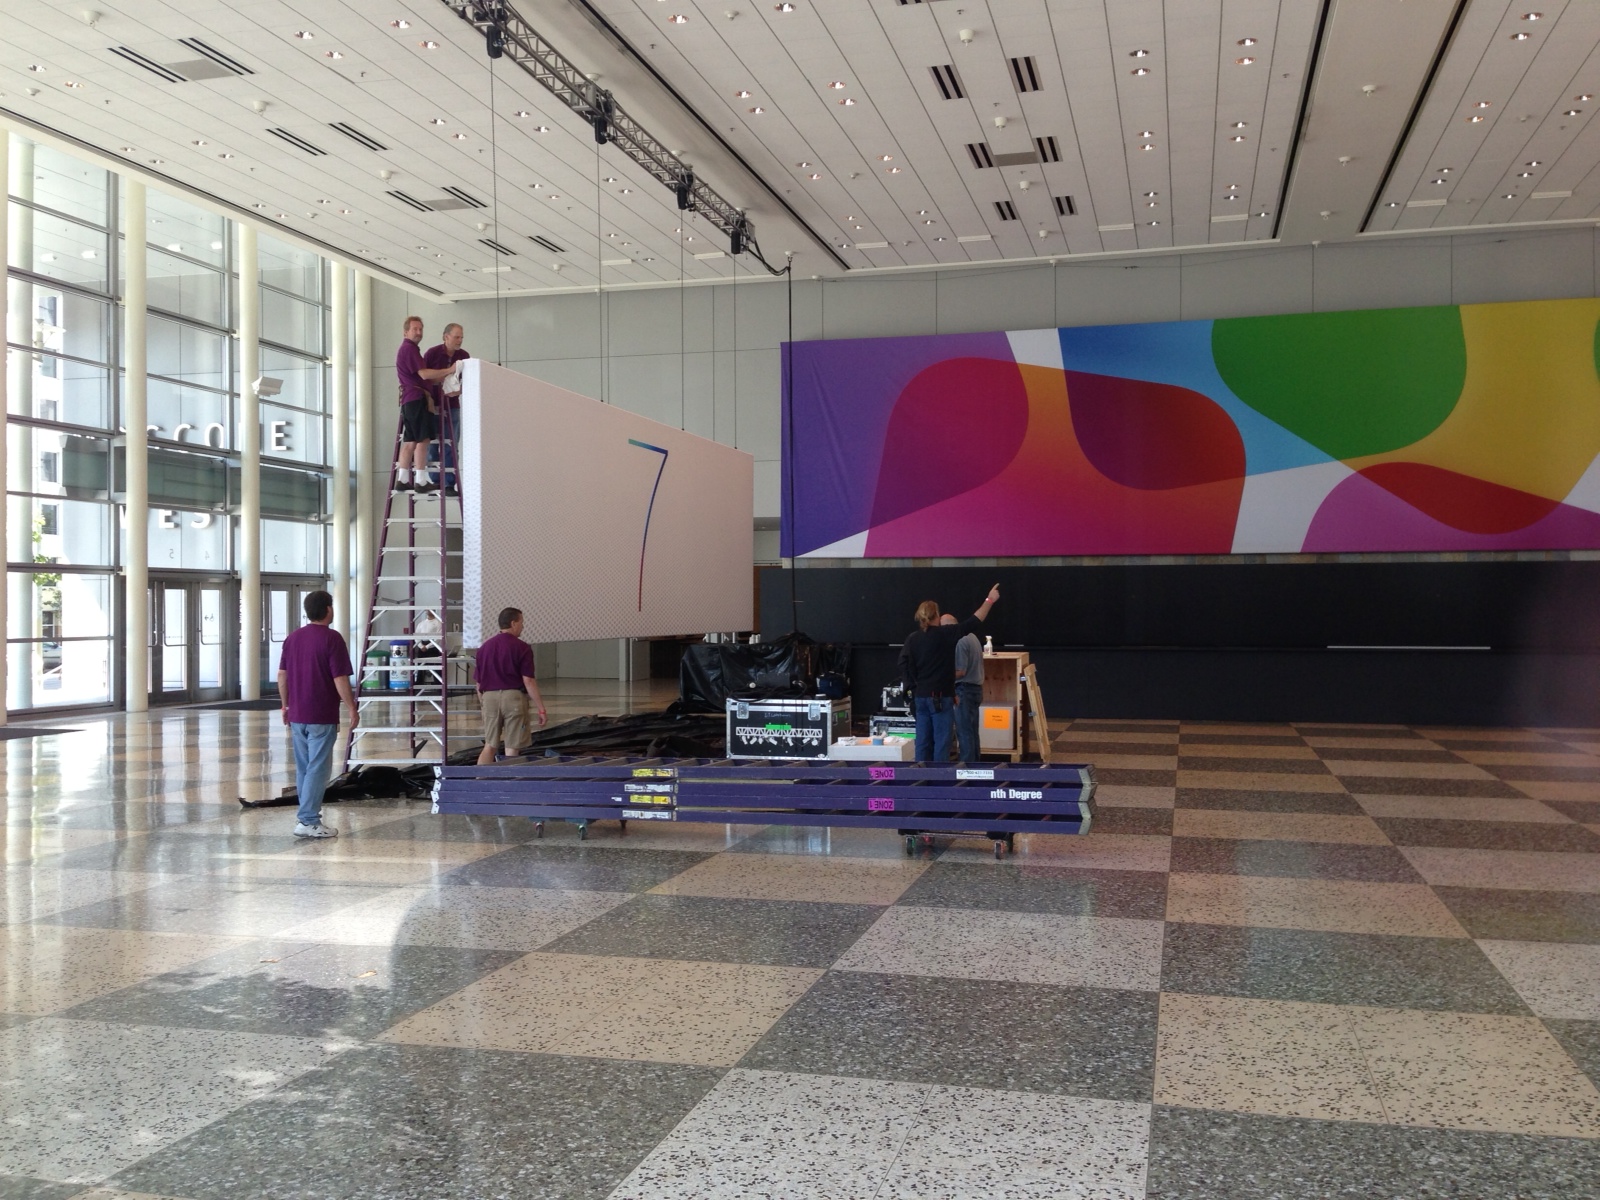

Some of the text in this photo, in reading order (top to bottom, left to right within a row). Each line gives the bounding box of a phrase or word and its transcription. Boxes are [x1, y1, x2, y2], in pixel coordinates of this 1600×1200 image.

[874, 769, 894, 779] ZONE
[990, 789, 1043, 800] nth Degree
[874, 800, 893, 810] ZONE
